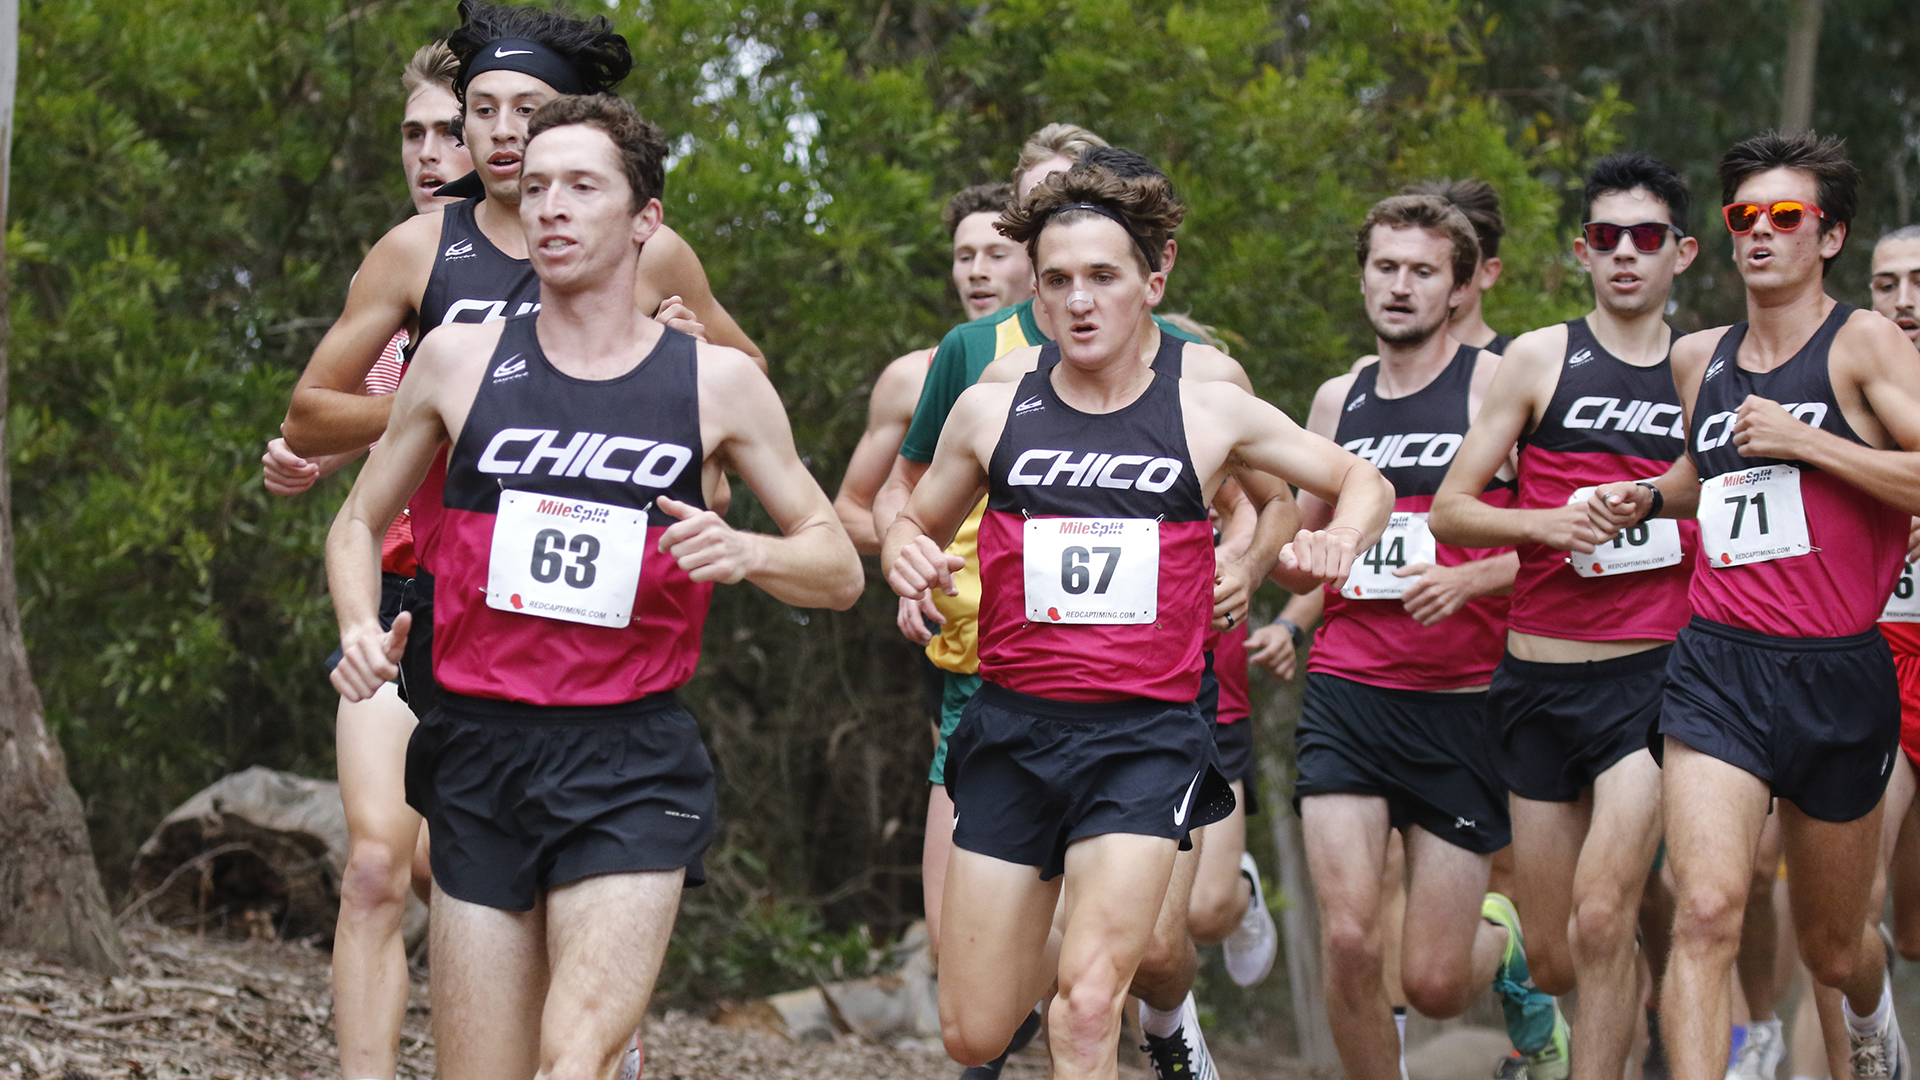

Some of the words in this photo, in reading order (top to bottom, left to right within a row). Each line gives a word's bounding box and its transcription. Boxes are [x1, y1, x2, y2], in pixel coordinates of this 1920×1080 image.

[477, 428, 692, 488] CHICO
[1007, 449, 1183, 493] CHICO
[1722, 468, 1772, 488] MileSplit
[536, 499, 610, 524] MileSplit
[1724, 491, 1770, 540] 71
[1059, 521, 1124, 537] MileSplit
[530, 528, 601, 590] 63
[1363, 536, 1407, 574] 44
[1607, 556, 1665, 570] REDCAPTIMING.COM
[1734, 546, 1791, 560] REDCAPTIMING.COM
[1061, 545, 1122, 595] 67
[528, 600, 607, 620] REDCAPTIMING.COM
[1065, 611, 1136, 619] REDCAPTIMING.COM
